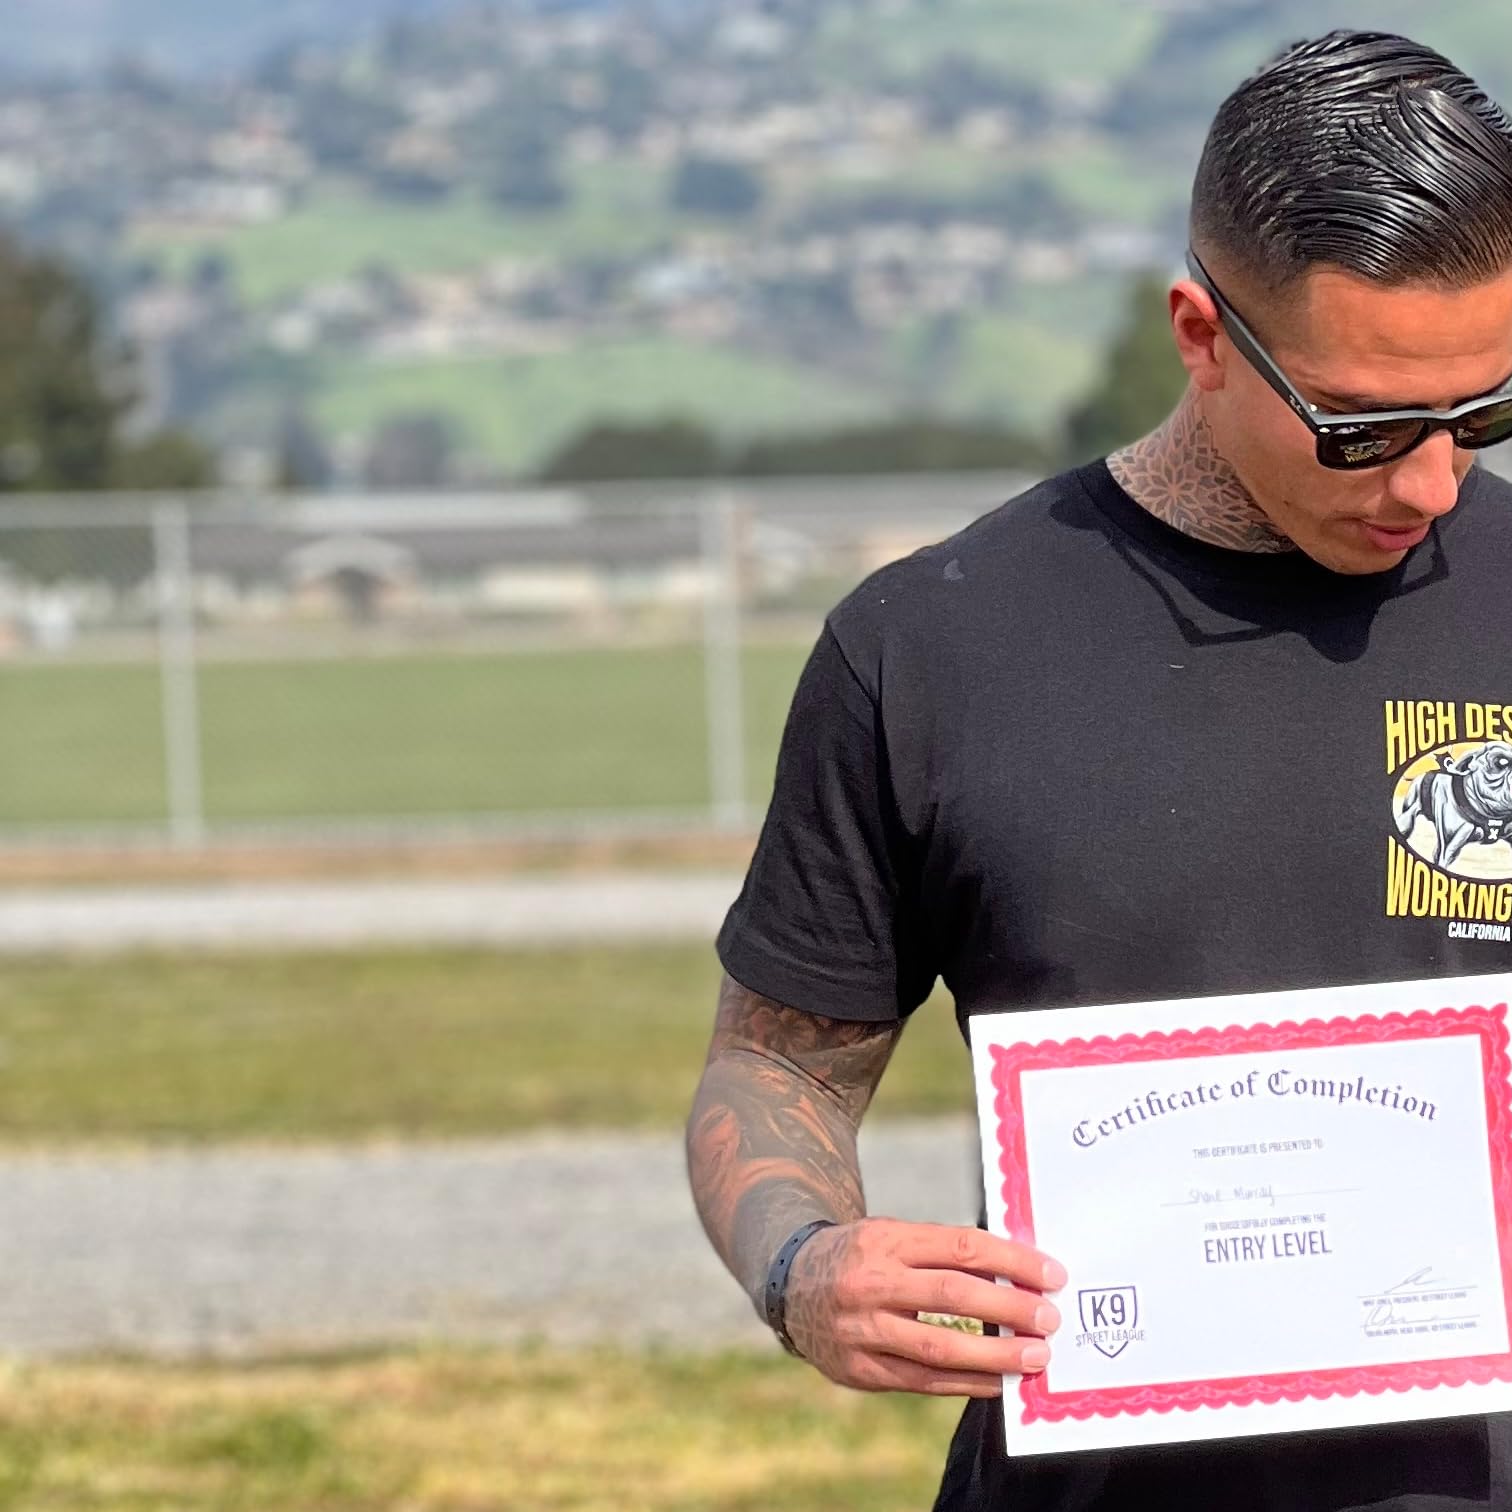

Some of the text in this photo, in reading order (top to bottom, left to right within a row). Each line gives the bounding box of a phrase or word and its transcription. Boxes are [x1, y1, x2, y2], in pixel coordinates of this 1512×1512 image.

[1384, 700, 1457, 775] HIGH
[1386, 834, 1512, 923] WORKING
[1448, 921, 1511, 942] CALIFORNIA
[1072, 1068, 1436, 1148] Certificate of Completion
[1212, 1143, 1258, 1158] CERTIFICATE
[1269, 1139, 1312, 1153] PRESENTED
[1203, 1229, 1333, 1264] ENTRY LEVEL
[1091, 1293, 1126, 1328] K9
[1075, 1328, 1145, 1348] STREET LEAGUE
